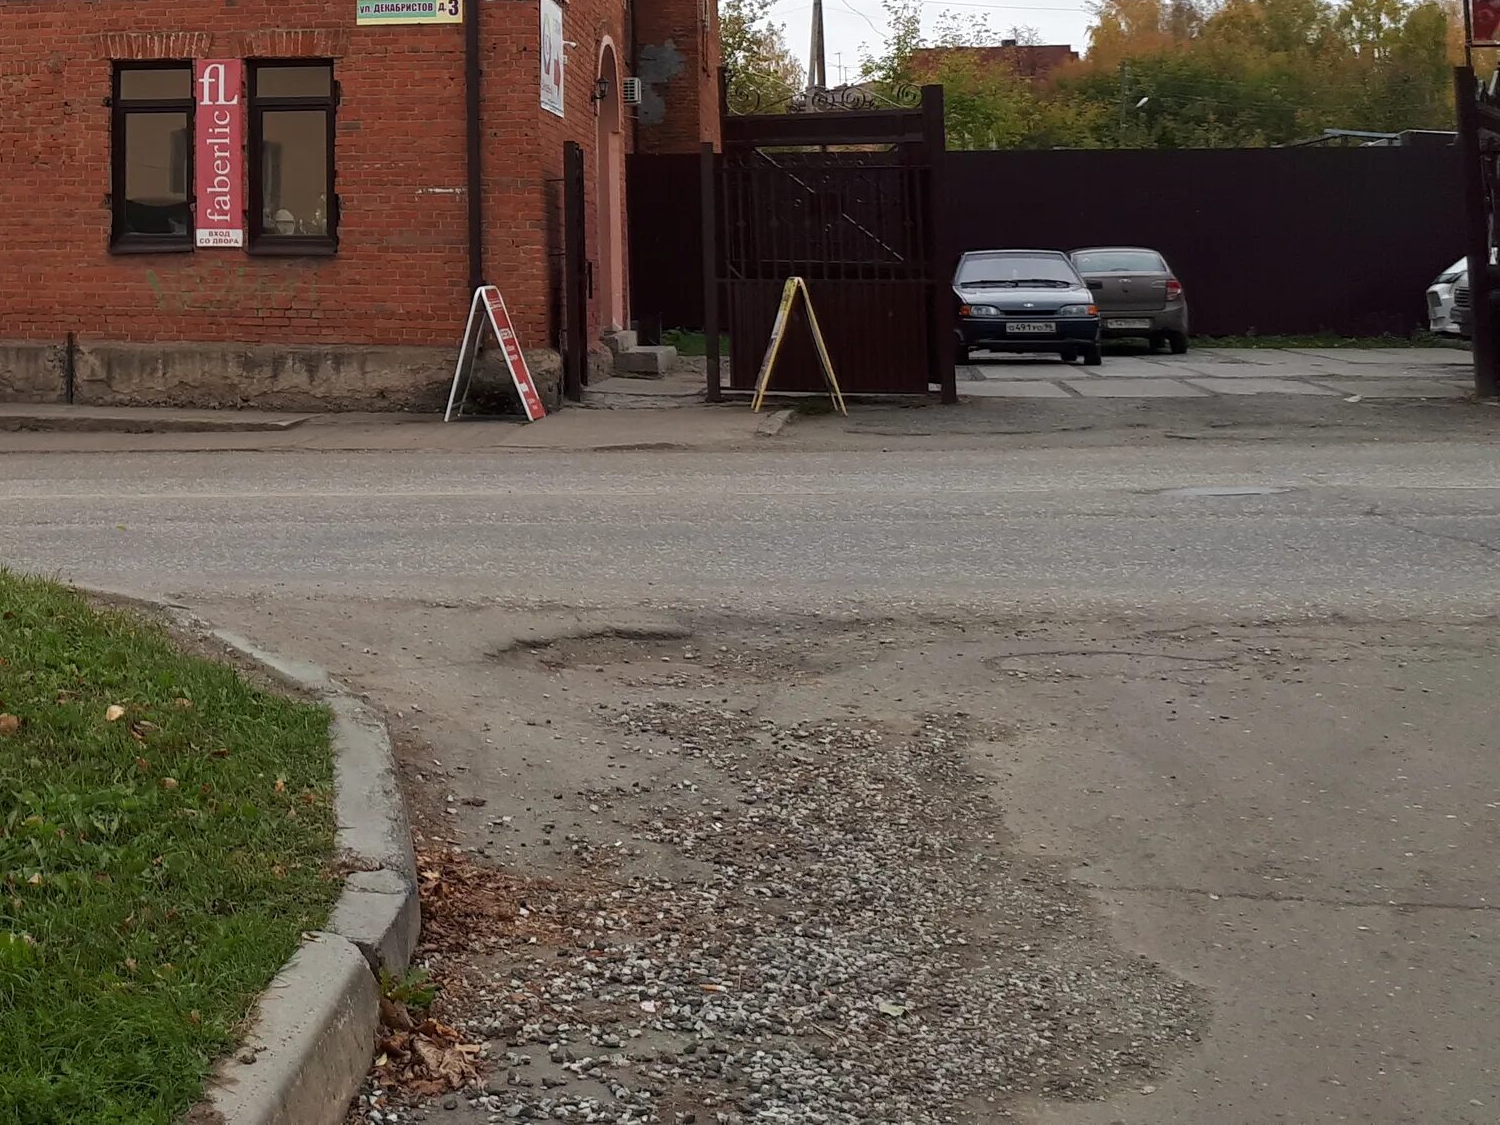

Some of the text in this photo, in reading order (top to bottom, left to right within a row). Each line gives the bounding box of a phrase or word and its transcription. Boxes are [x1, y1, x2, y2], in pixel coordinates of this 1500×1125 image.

[373, 2, 433, 14] ДЕКАБРИСТОВ
[206, 110, 231, 223] faberlic
[208, 230, 231, 238] ВХОД
[212, 237, 239, 245] ДВОРА
